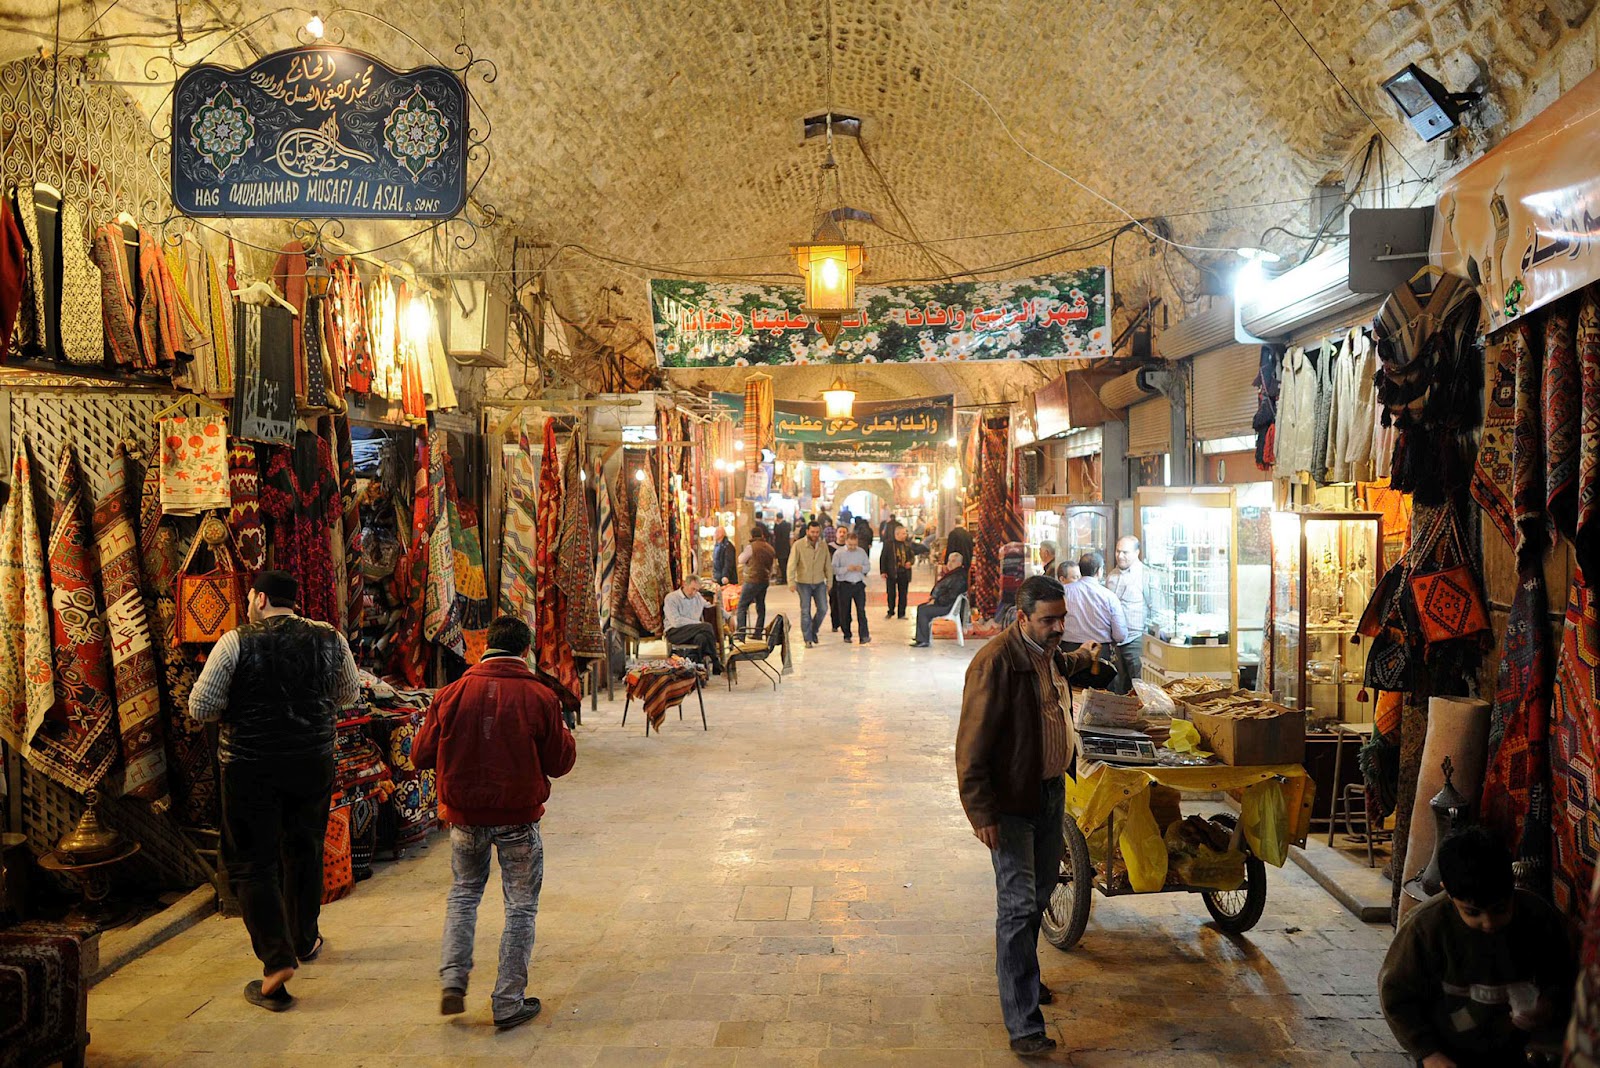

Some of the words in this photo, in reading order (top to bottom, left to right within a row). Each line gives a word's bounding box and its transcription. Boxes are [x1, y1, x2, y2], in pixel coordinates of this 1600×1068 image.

[286, 54, 336, 83] الحاج
[344, 64, 374, 105] محمد
[195, 188, 220, 206] HAG
[229, 180, 300, 207] MUHAMMAD
[306, 178, 353, 205] MUSAFI
[352, 180, 369, 208] AL
[372, 183, 404, 212] ASAL
[405, 201, 412, 212] &
[414, 198, 440, 212] SONS
[751, 308, 810, 337] علينا
[905, 304, 967, 332] وافانا
[970, 296, 1037, 332] الربيع
[1038, 295, 1089, 328] شهر
[778, 415, 823, 434] عظيم
